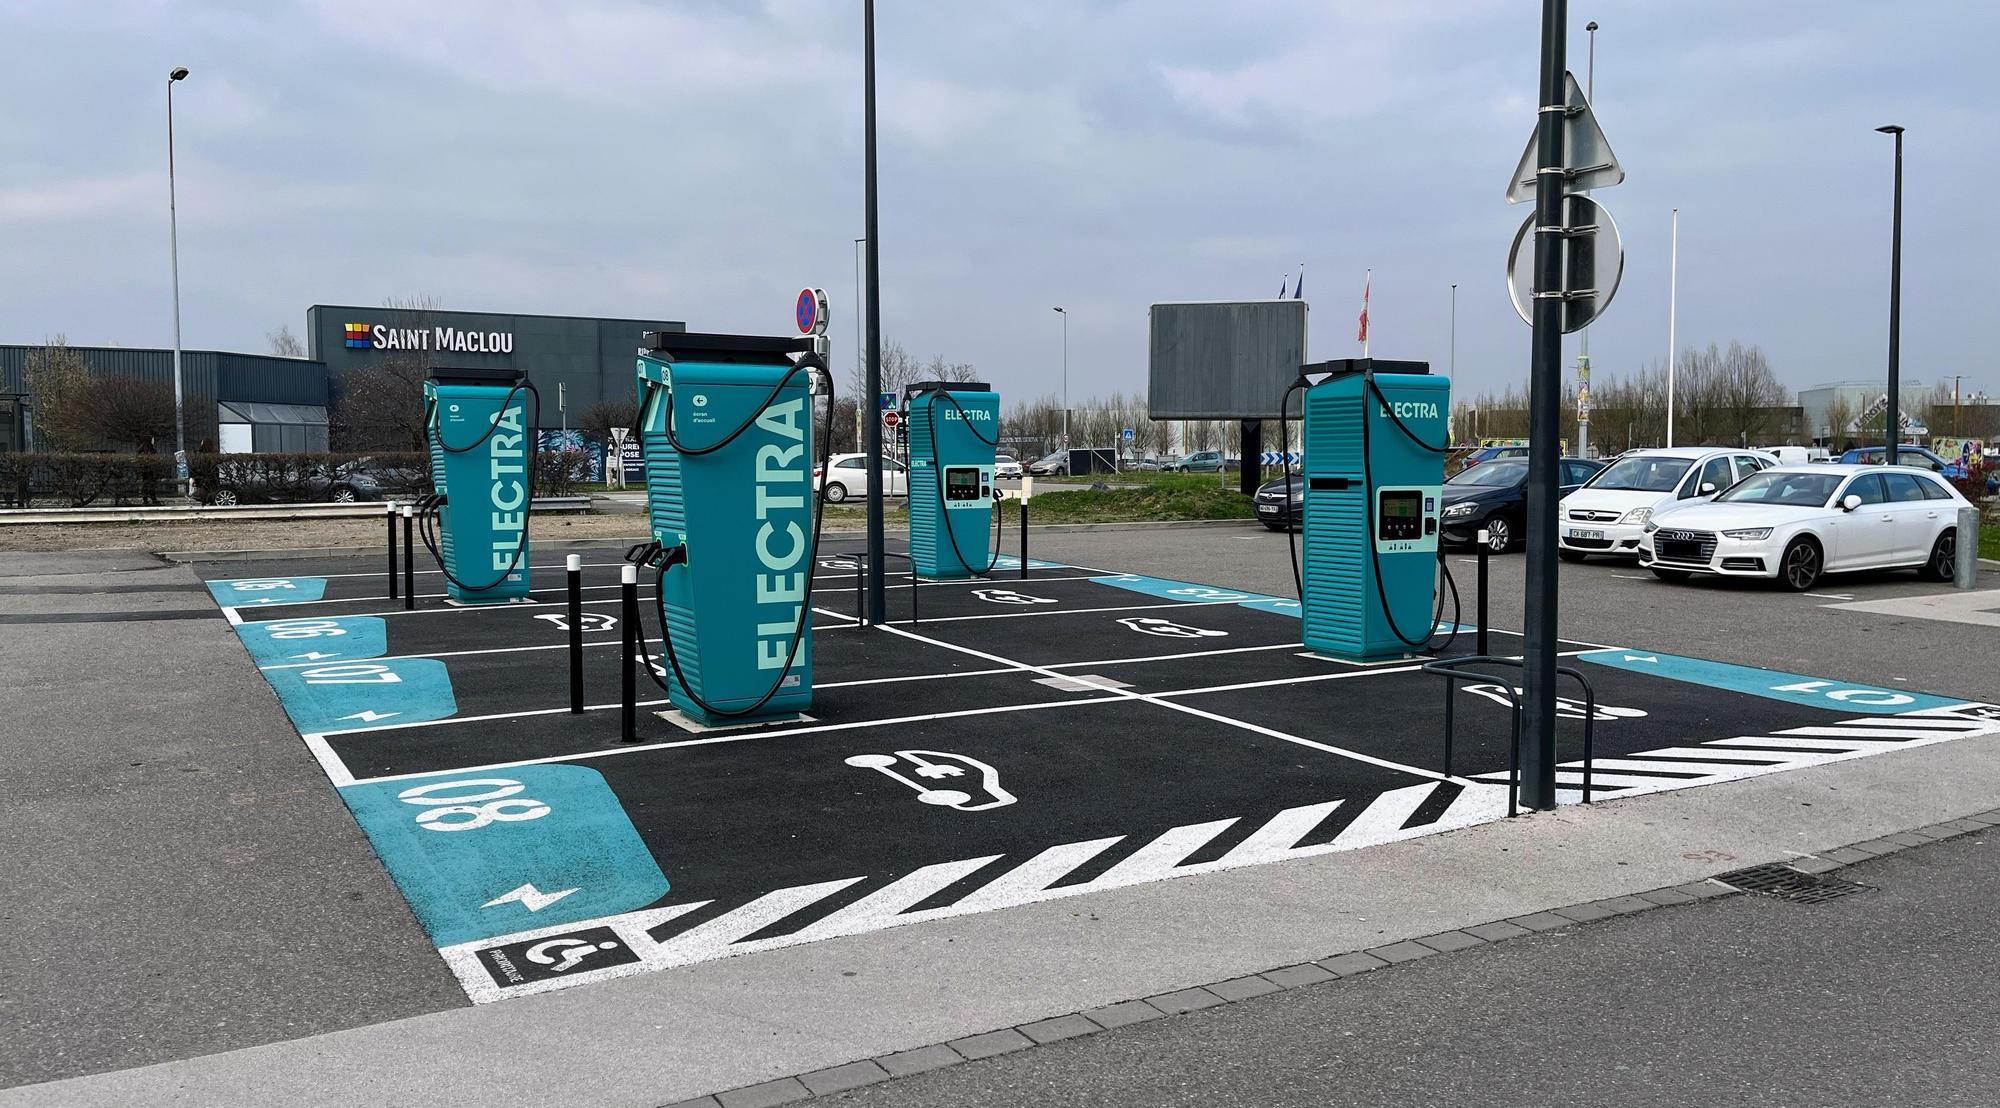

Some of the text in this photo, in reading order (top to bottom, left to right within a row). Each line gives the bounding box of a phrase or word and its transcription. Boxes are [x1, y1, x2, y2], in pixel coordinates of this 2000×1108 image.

[373, 325, 513, 353] SAINT MACLOU
[945, 409, 991, 420] ELECTRA
[1380, 402, 1438, 418] EECTRA
[490, 406, 525, 570] ELECTRA
[755, 398, 805, 670] ELECTRA
[231, 579, 296, 591] 05
[1166, 588, 1248, 600] 03
[265, 620, 347, 639] 06
[300, 664, 402, 684] 07
[1769, 681, 1915, 705] 01
[397, 778, 552, 832] 08
